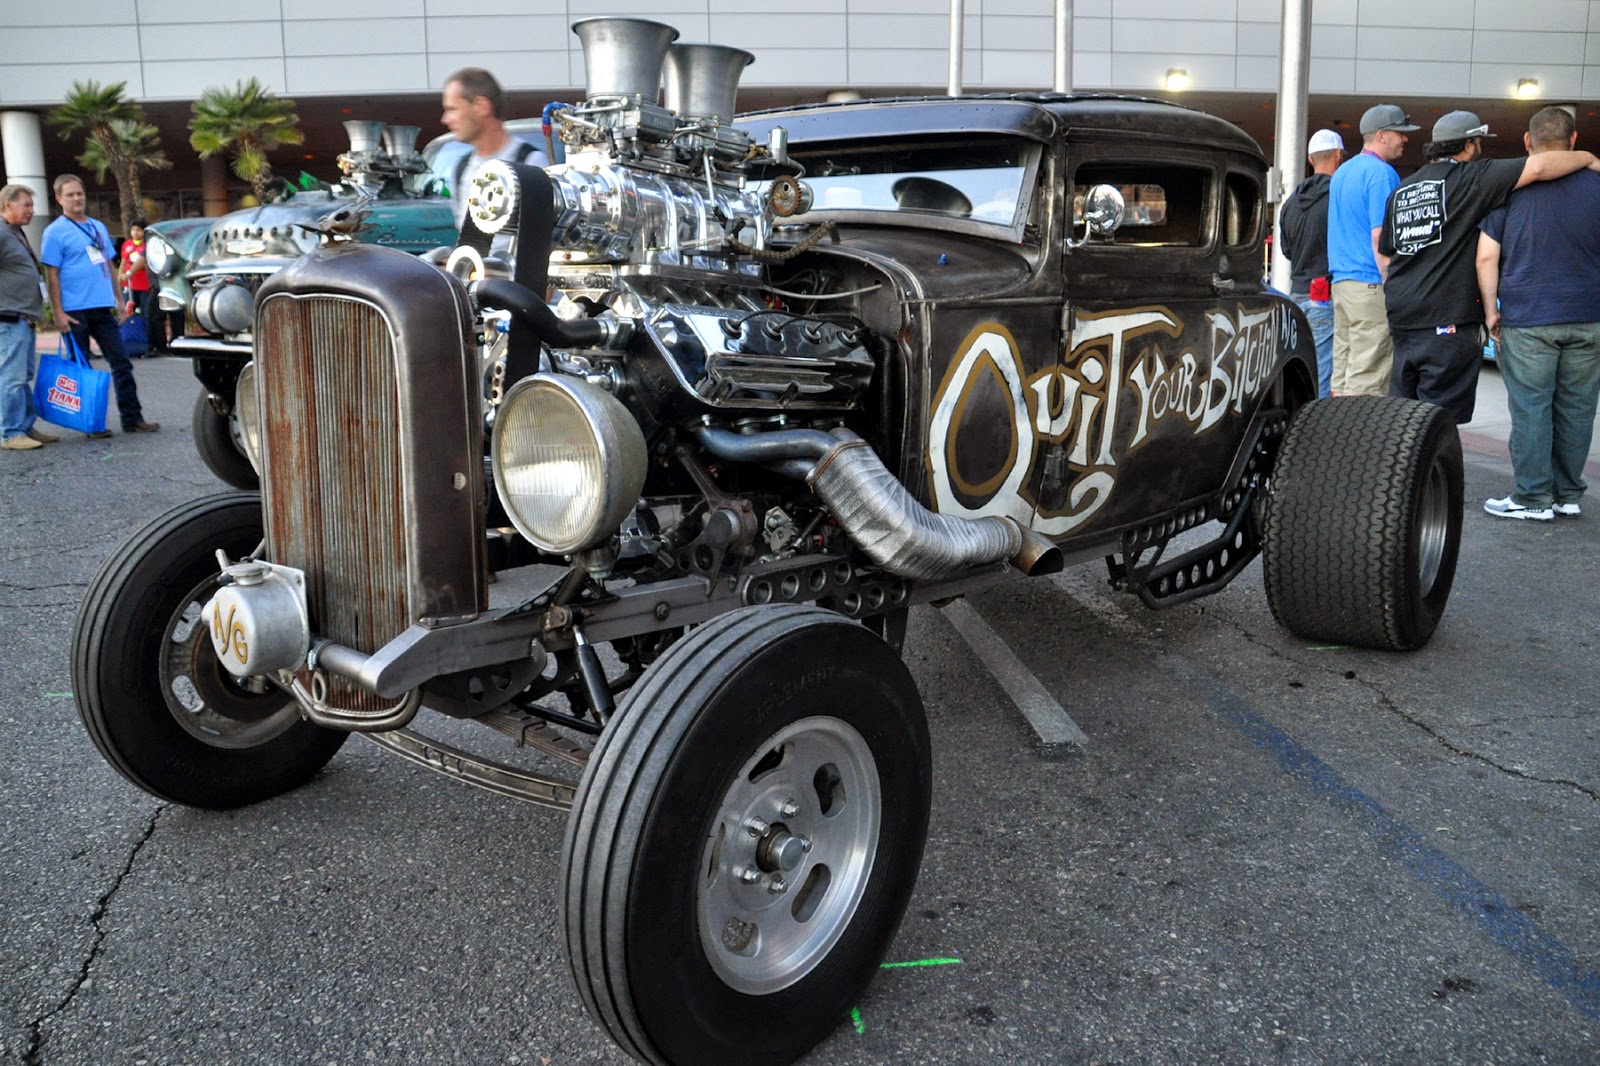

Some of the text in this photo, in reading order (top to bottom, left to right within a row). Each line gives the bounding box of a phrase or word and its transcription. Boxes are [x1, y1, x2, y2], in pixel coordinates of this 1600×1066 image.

[1396, 205, 1440, 224] WHAT YOU CALL
[1409, 191, 1440, 205] BECOME
[1281, 302, 1298, 350] A/G
[213, 602, 248, 665] A/G
